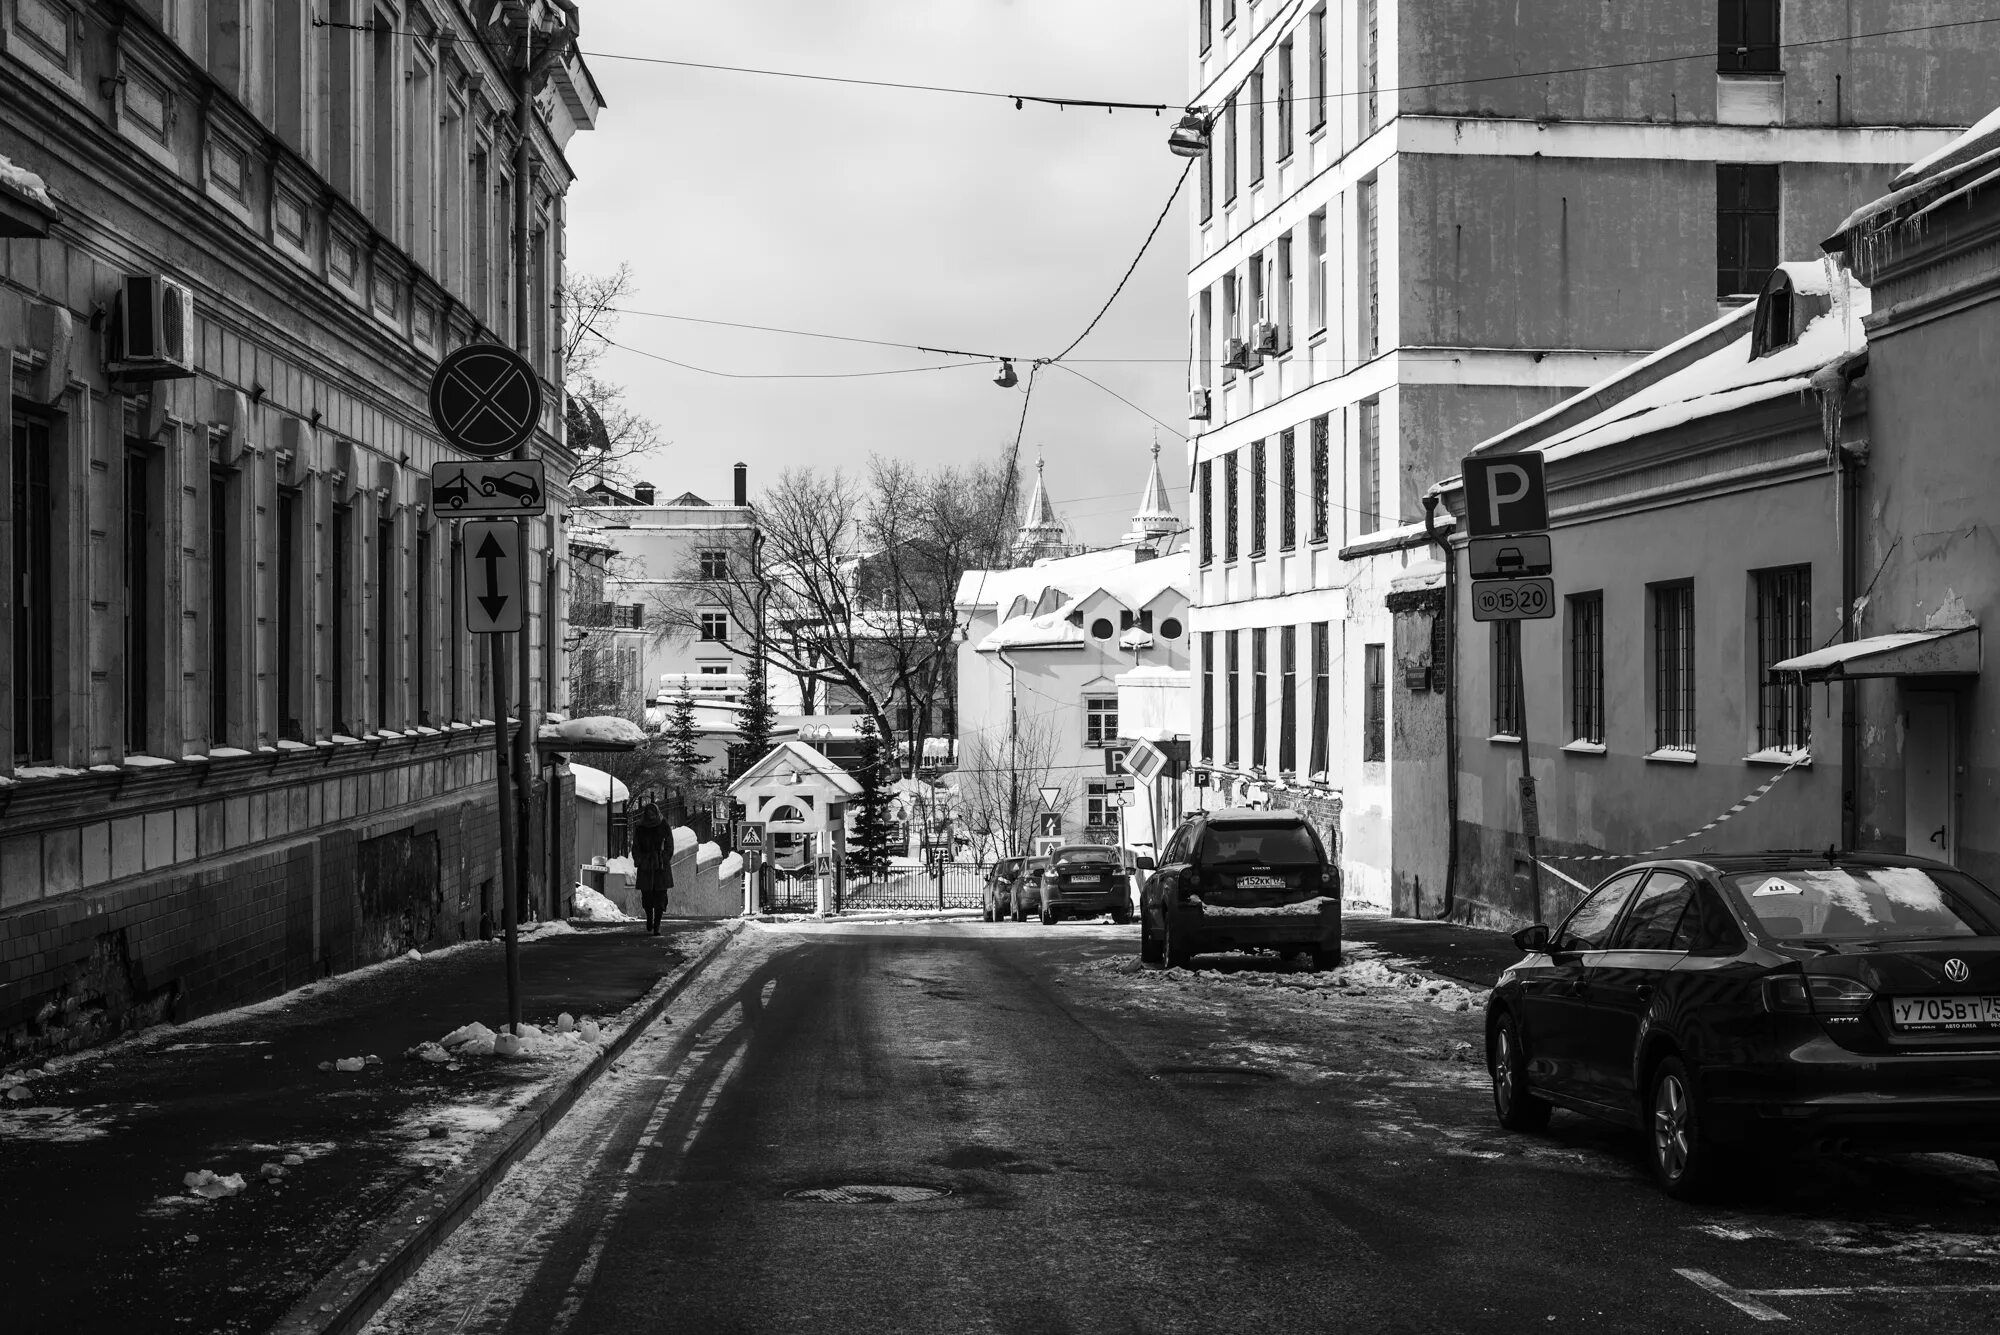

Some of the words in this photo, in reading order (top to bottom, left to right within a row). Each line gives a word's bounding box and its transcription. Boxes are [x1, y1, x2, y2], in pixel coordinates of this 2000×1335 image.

[1486, 464, 1530, 527] P
[1499, 593, 1514, 607] 15
[1520, 591, 1543, 607] 20
[1198, 774, 1205, 784] P
